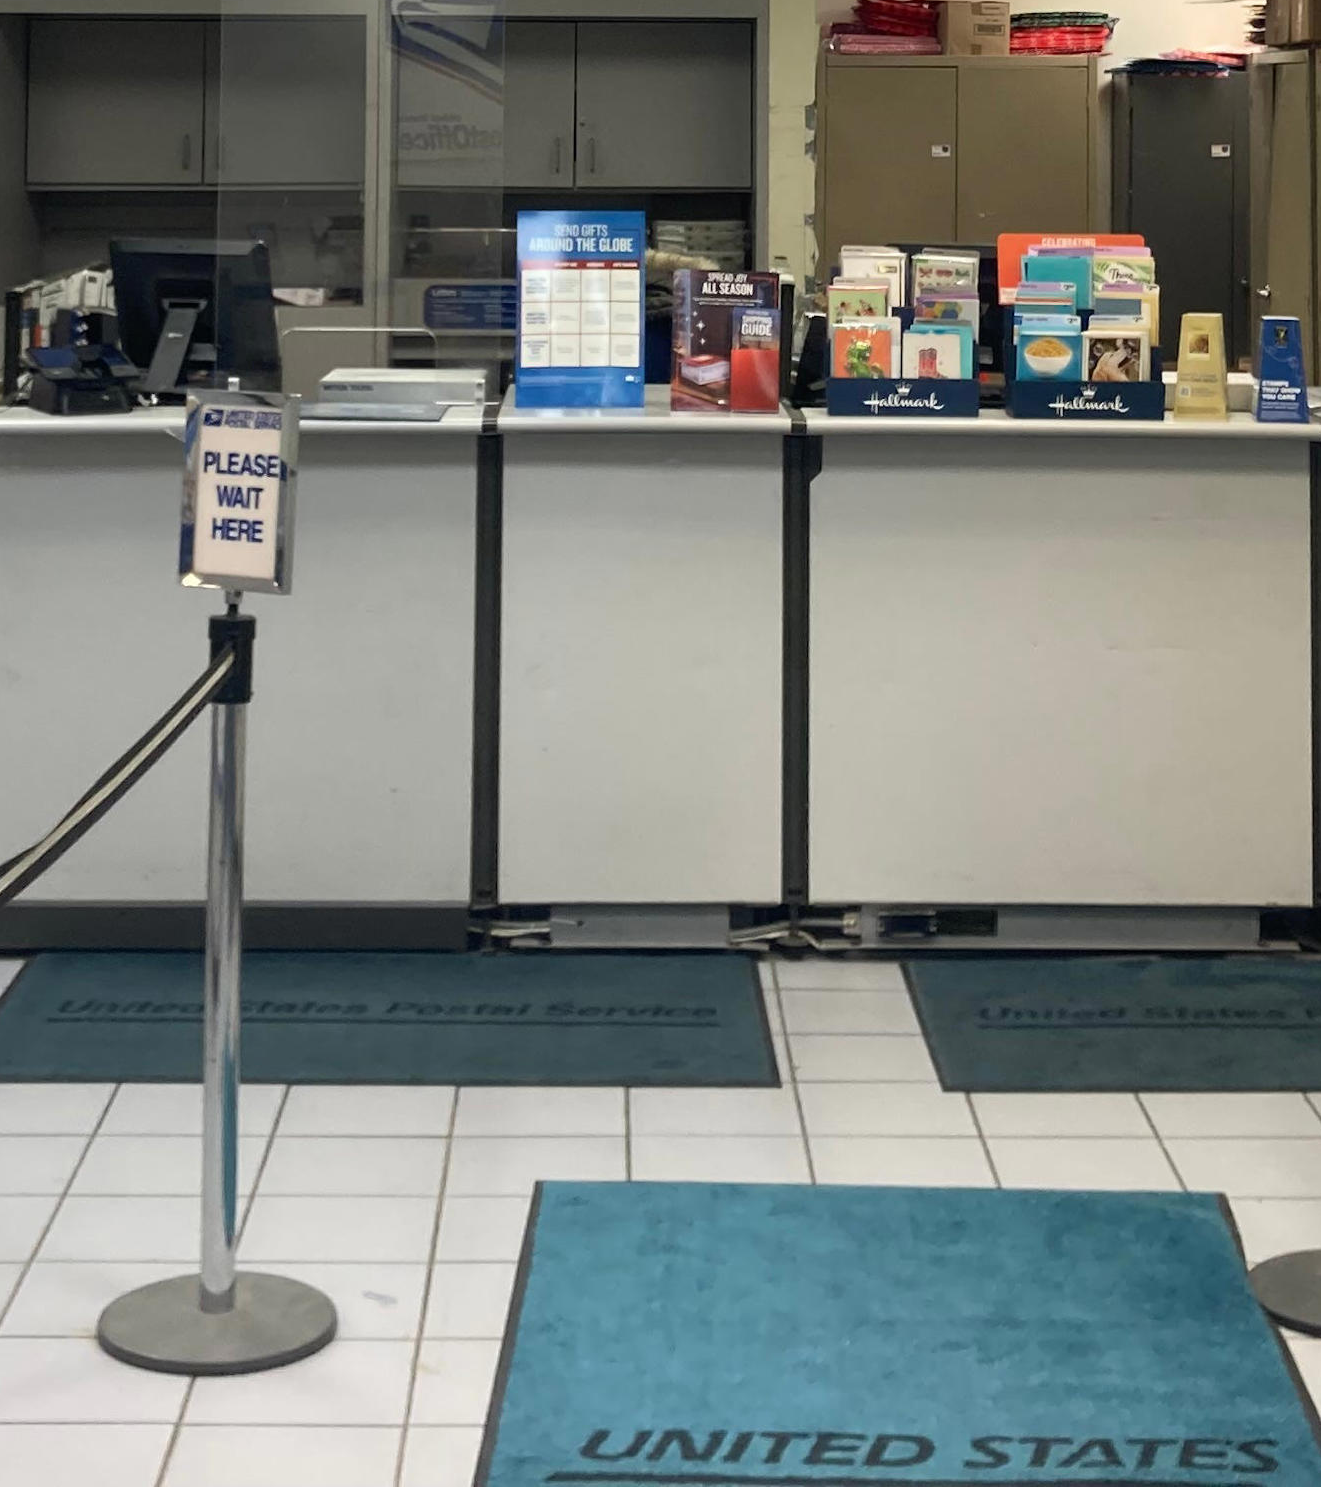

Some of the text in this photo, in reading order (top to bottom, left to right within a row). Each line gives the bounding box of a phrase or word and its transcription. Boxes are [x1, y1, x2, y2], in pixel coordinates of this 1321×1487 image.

[554, 224, 608, 236] SEND GIFTS
[529, 238, 634, 253] AROUND THE GLOBE
[707, 273, 748, 284] SPREAD JOY
[701, 282, 754, 296] ALL SEASON
[741, 325, 773, 337] GUIDE
[863, 392, 945, 412] Hallmark
[1048, 394, 1130, 415] Hallmark
[204, 451, 279, 478] PLEASE
[216, 485, 264, 510] WAIT
[211, 518, 264, 543] HERE
[579, 1430, 1280, 1473] UNITED STATES
